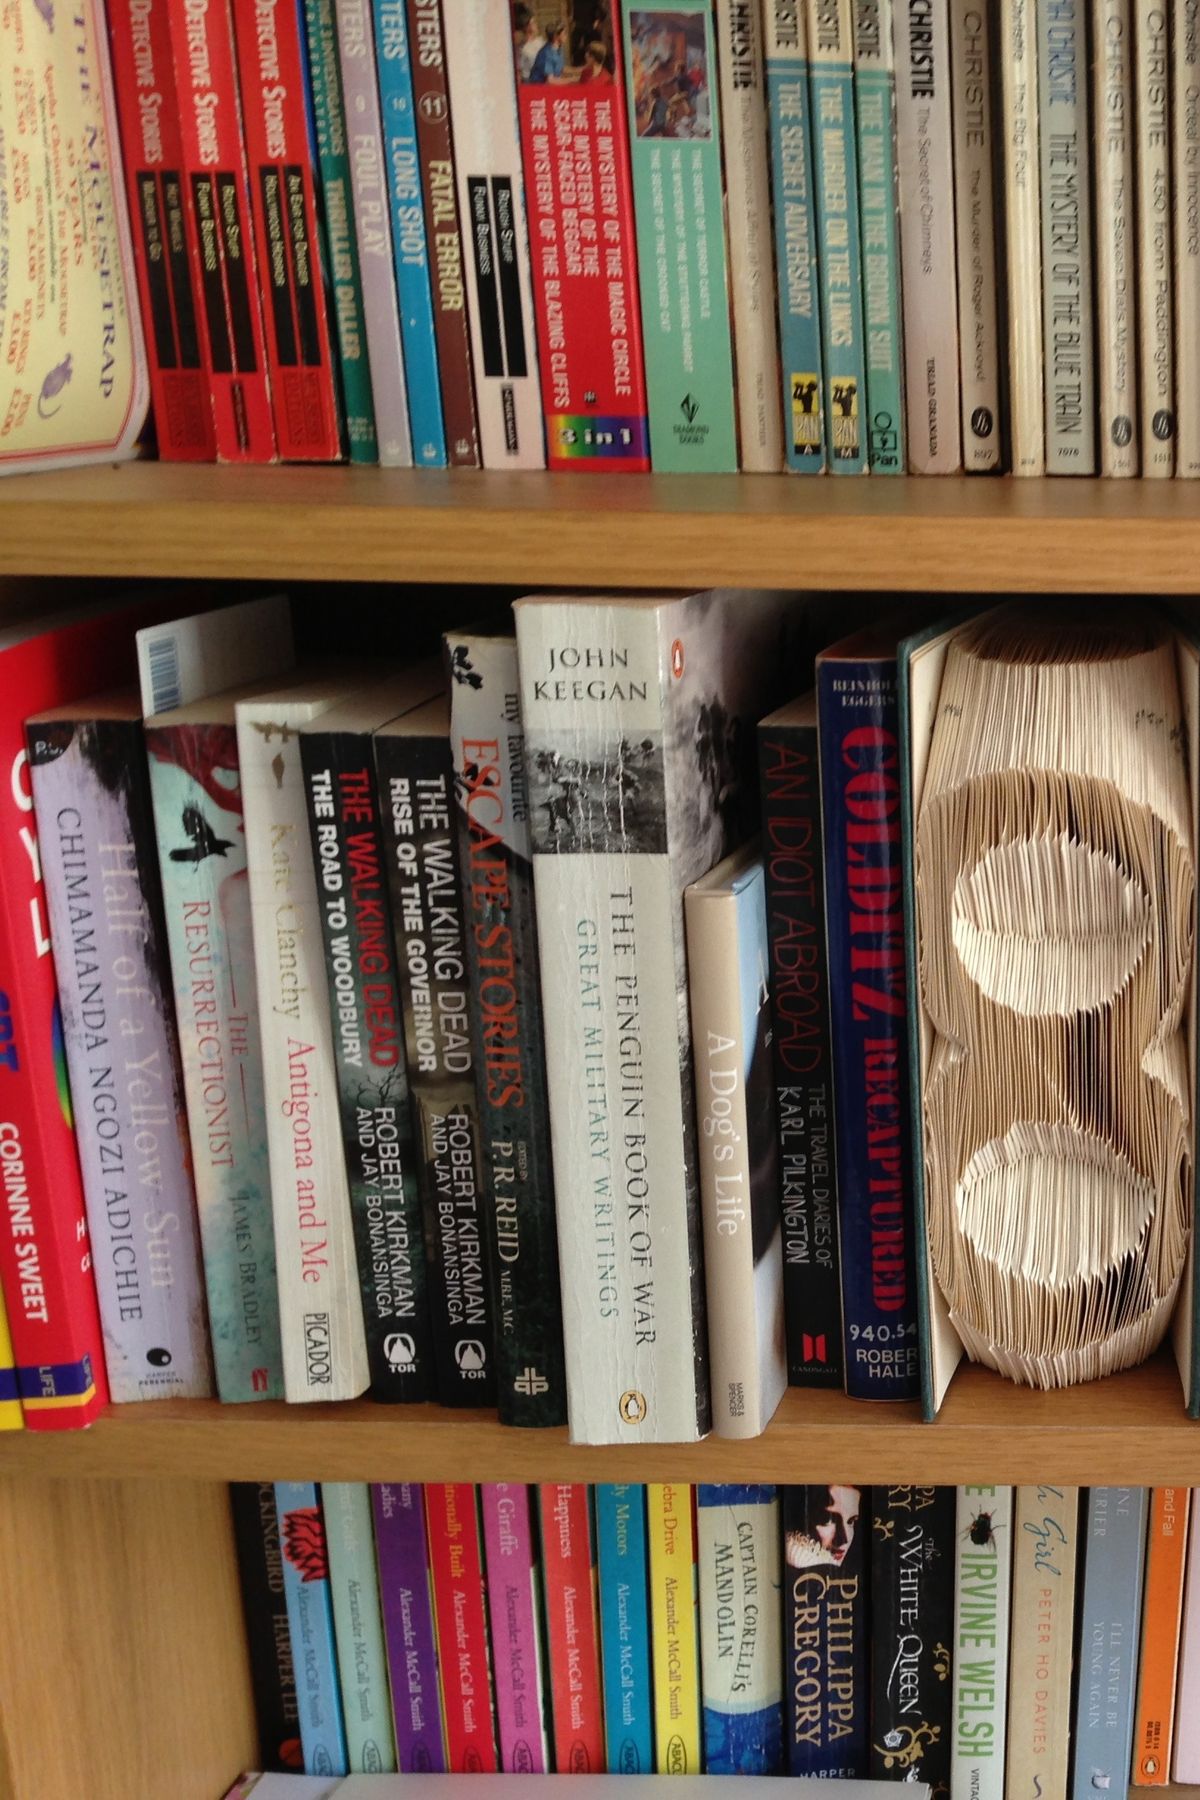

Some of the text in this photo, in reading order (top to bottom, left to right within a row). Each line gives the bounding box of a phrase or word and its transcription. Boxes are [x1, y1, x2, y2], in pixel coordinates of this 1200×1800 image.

[186, 0, 220, 166] DETECTIVE STORIES
[908, 0, 936, 99] CHRISTIE
[325, 180, 359, 359] THRILLER DILLER
[355, 134, 386, 257] FOUL PLAY
[392, 136, 424, 267] LONG SHOT
[429, 160, 464, 311] FATAL ERROR
[594, 101, 632, 395] THE MYSTERY OF THE MAGIC CIRCLE
[778, 83, 811, 318] THE SECRET ADVERSARY
[1049, 130, 1083, 434] THE MYSTERY OF THE BLUE TRAIN
[533, 681, 649, 702] KEEGAN
[550, 648, 631, 670] JOHN
[310, 770, 363, 1067] THE ROAD TO WOODBURY
[337, 768, 399, 1067] THE WALKING DEAD
[840, 725, 906, 1024] COLDITZ
[55, 807, 142, 1324] CHIMAMANDA NGOZI ADICHIE
[97, 841, 181, 1290] Half of a Yellow Sun
[182, 900, 235, 1170] RESURRECTIONIST
[228, 1012, 250, 1057] THE
[610, 889, 657, 1347] THE PENGUIN BOOK OF WAR
[276, 1037, 327, 1285] Antigona and Me
[375, 1106, 416, 1318] ROBERT KIRKMAN
[703, 1030, 744, 1238] A Dog's Life
[863, 1037, 909, 1312] RECAPTURED
[0, 1122, 48, 1324] CORINNE SWEET
[37, 1366, 57, 1399] LIFE
[304, 1312, 330, 1387] PICADOR
[849, 1323, 918, 1342] 940.54
[868, 1362, 917, 1379] HALE
[498, 1498, 519, 1557] Giraffe
[553, 1485, 575, 1559] Happiness
[714, 1542, 736, 1659] MANDOLIN
[737, 1522, 759, 1596] CAPTAIN
[664, 1577, 683, 1719] Alexander McCall Smith
[793, 1573, 826, 1747] GREGORY
[826, 1574, 858, 1742] PHILIPPA
[886, 1525, 924, 1716] WHITE QUEEN
[957, 1553, 997, 1758] IRVINE WELSH
[1033, 1589, 1053, 1756] PETER HO DAVIES
